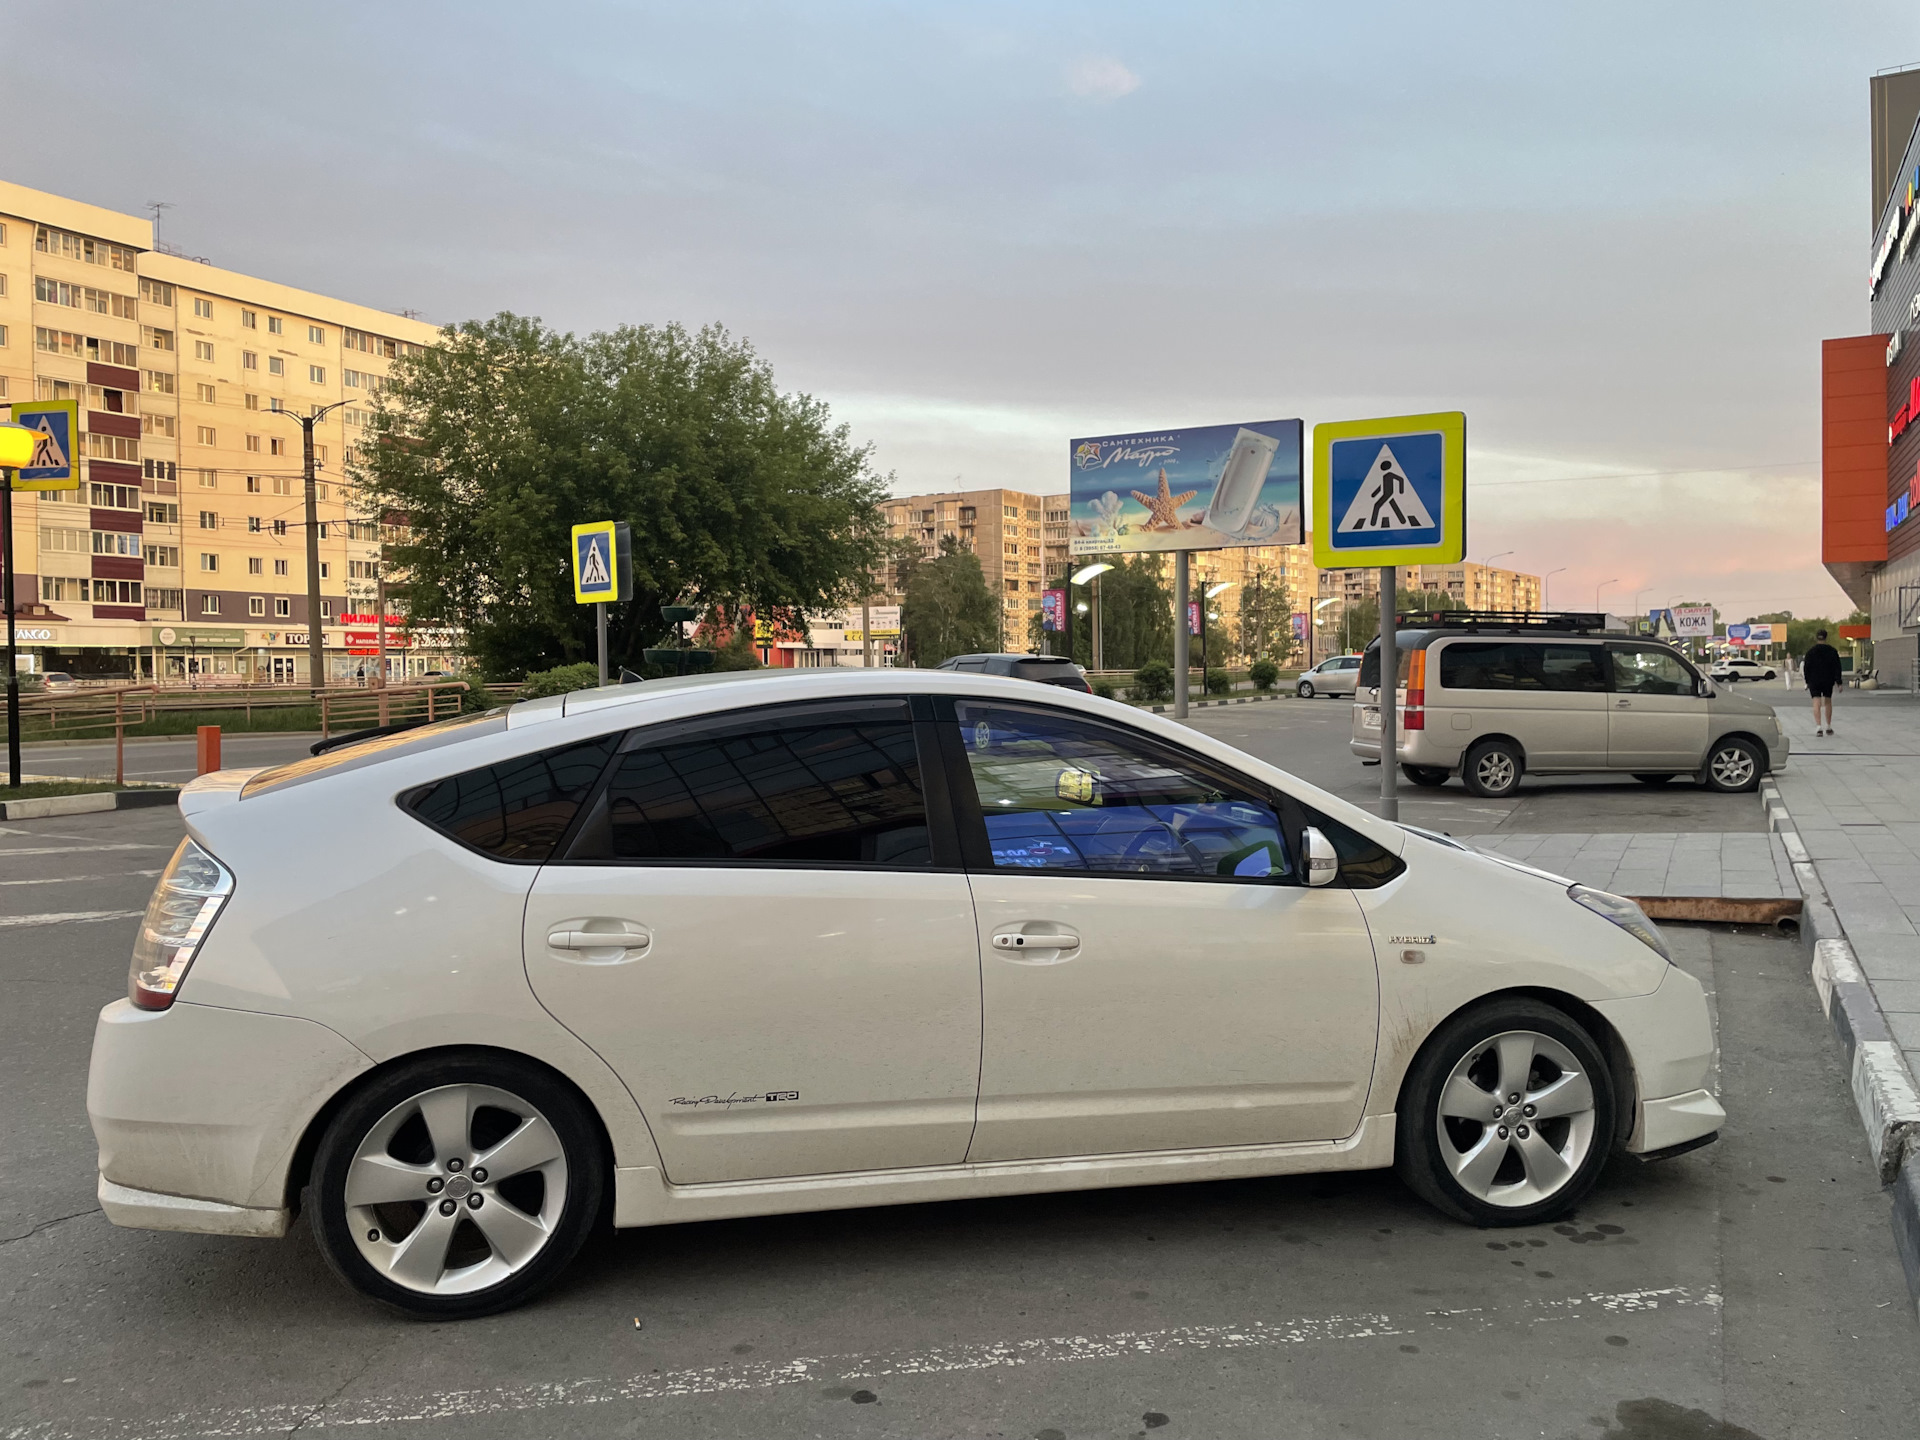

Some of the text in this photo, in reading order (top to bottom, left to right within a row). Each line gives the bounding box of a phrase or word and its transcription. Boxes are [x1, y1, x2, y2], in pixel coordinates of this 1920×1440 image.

[1102, 435, 1174, 447] САНТЕХНИКА
[1103, 446, 1180, 468] Мауро
[1055, 592, 1063, 630] ФЕСТИВАЛЬ
[1679, 616, 1707, 627] КОЖА
[15, 629, 51, 640] ANGO
[286, 633, 329, 644] ТОРЫ
